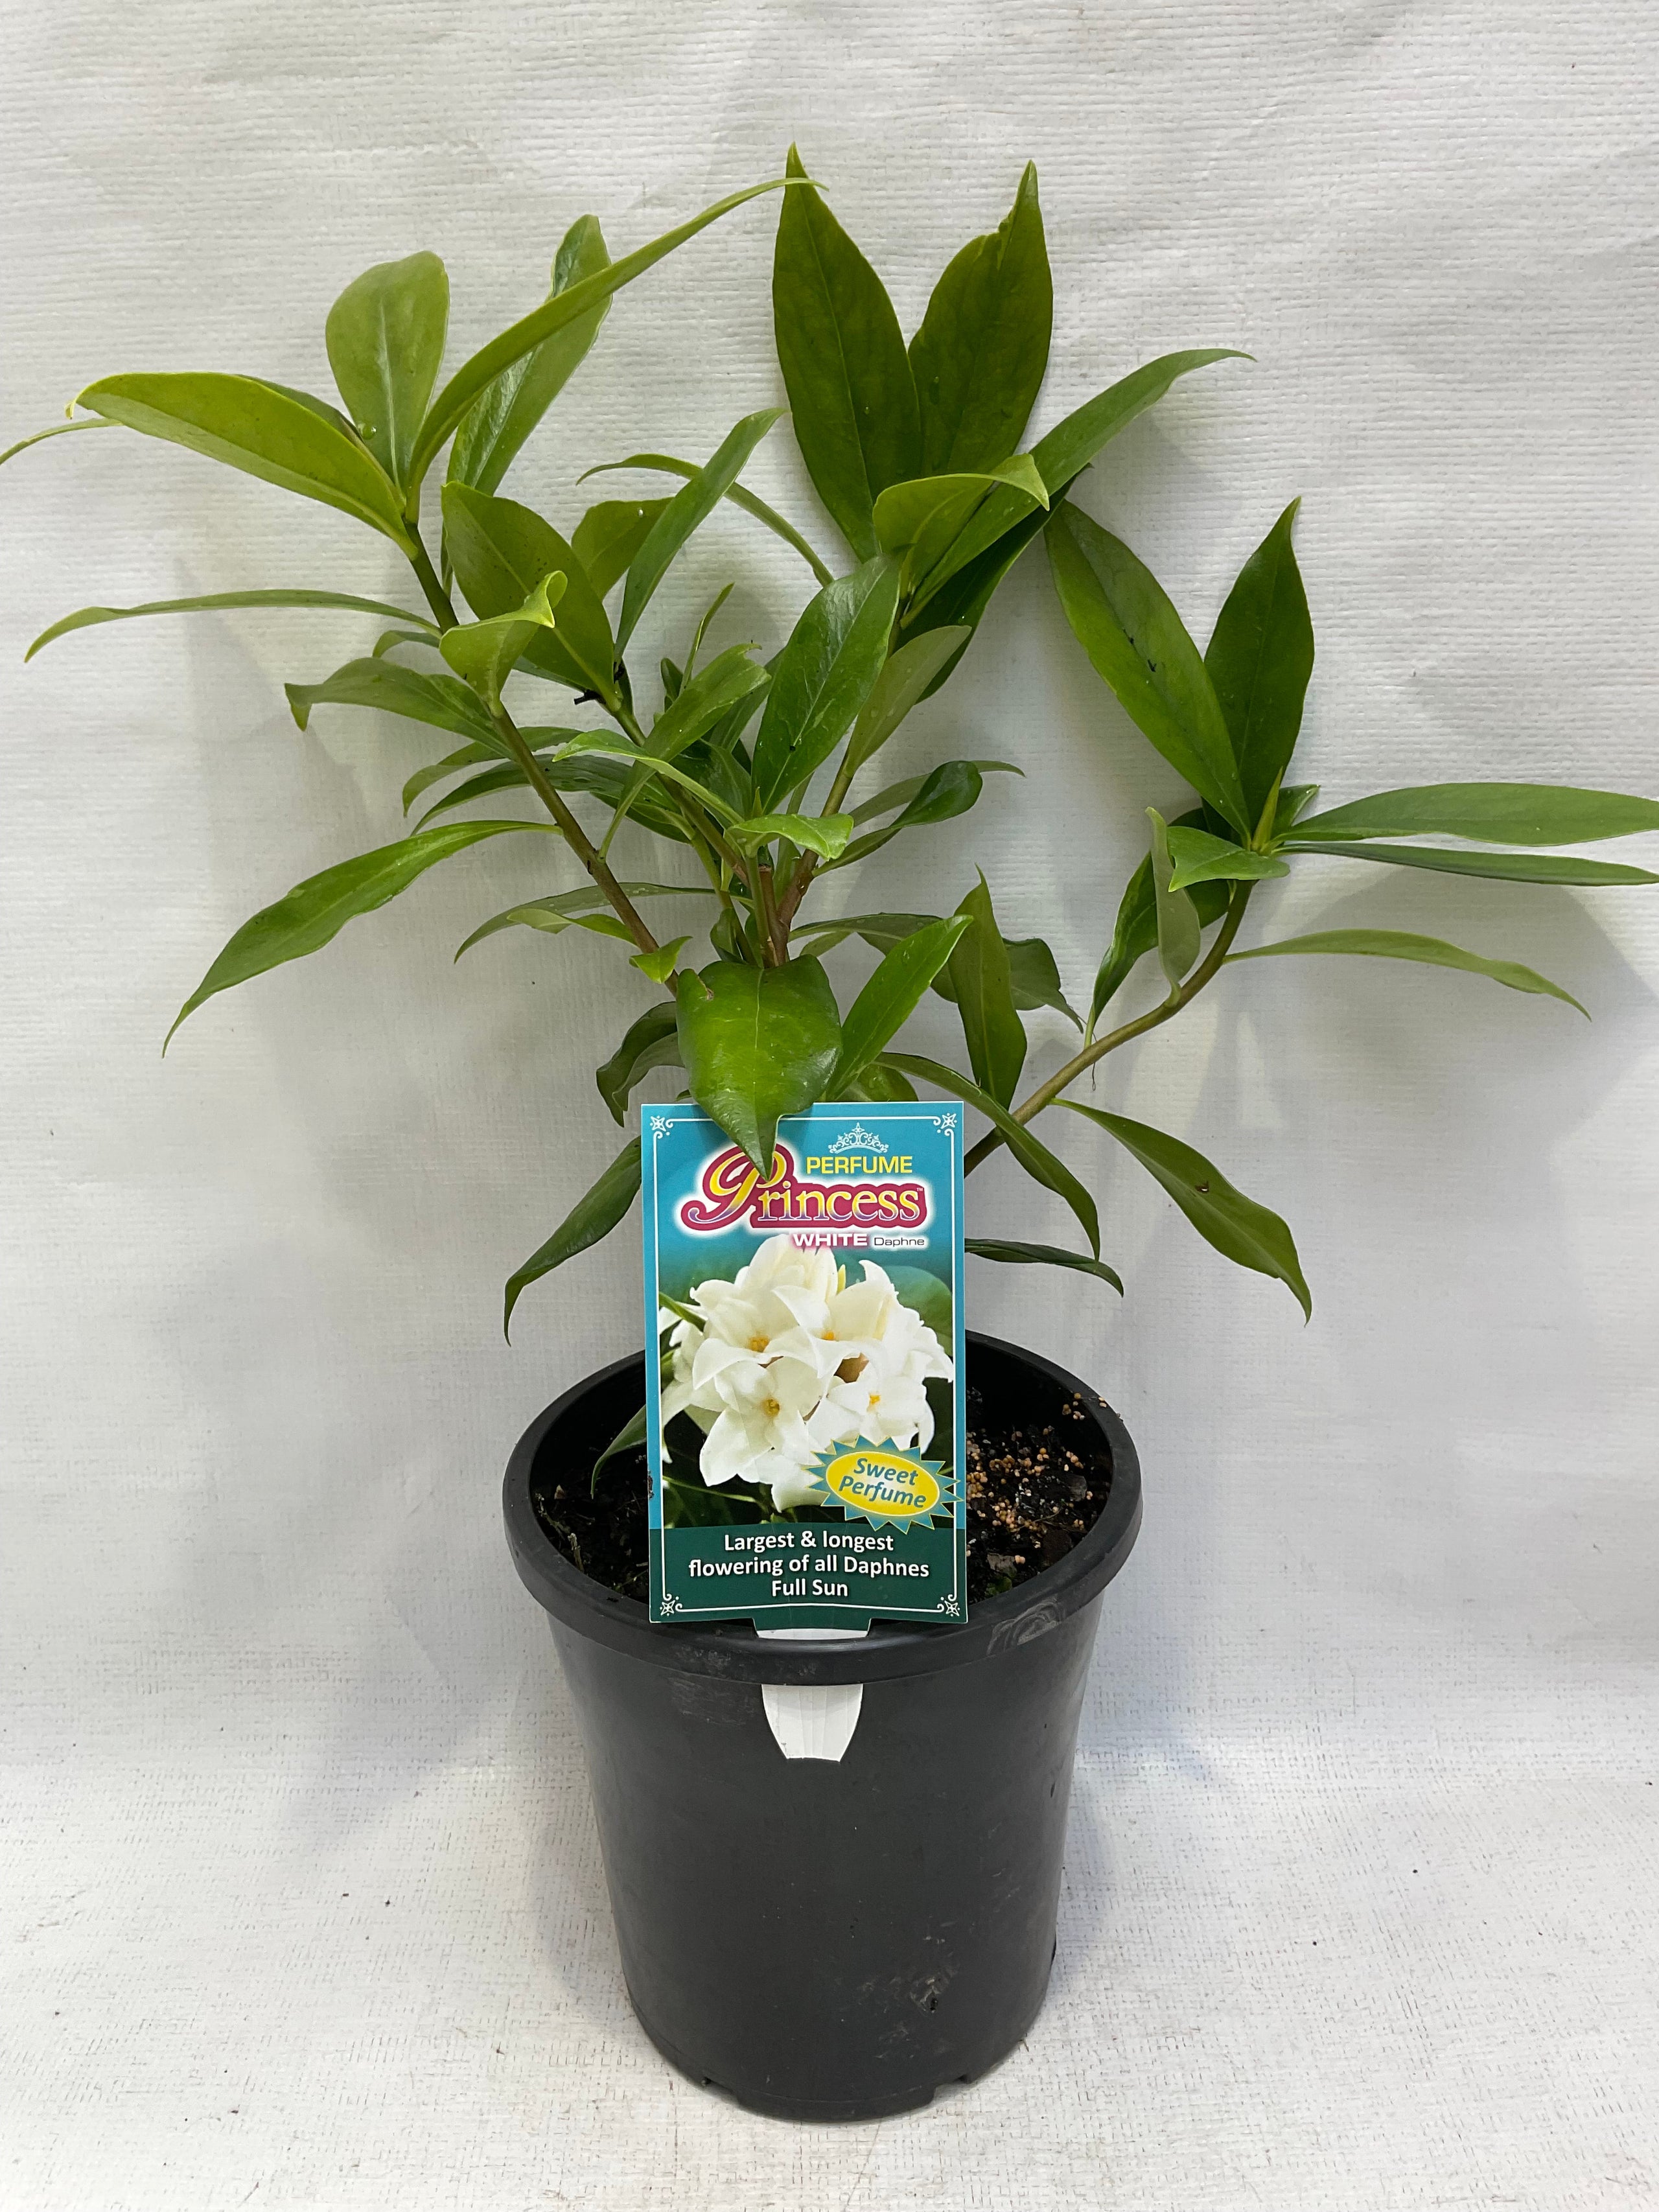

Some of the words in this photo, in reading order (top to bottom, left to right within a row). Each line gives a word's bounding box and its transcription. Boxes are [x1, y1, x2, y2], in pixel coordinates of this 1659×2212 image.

[806, 1156, 912, 1174] PERFUME
[793, 1233, 868, 1246] WHITE
[874, 1237, 925, 1248] Daphne
[853, 1458, 918, 1486] Sweet
[839, 1475, 927, 1508] Perfume
[725, 1533, 795, 1553] Largest
[800, 1531, 817, 1548] &
[823, 1531, 894, 1552] longest
[689, 1557, 782, 1578] flowering
[789, 1554, 809, 1572] of
[815, 1554, 838, 1572] all
[844, 1555, 929, 1578] Daphnes
[772, 1579, 806, 1596] Full
[812, 1579, 848, 1596] Sun
